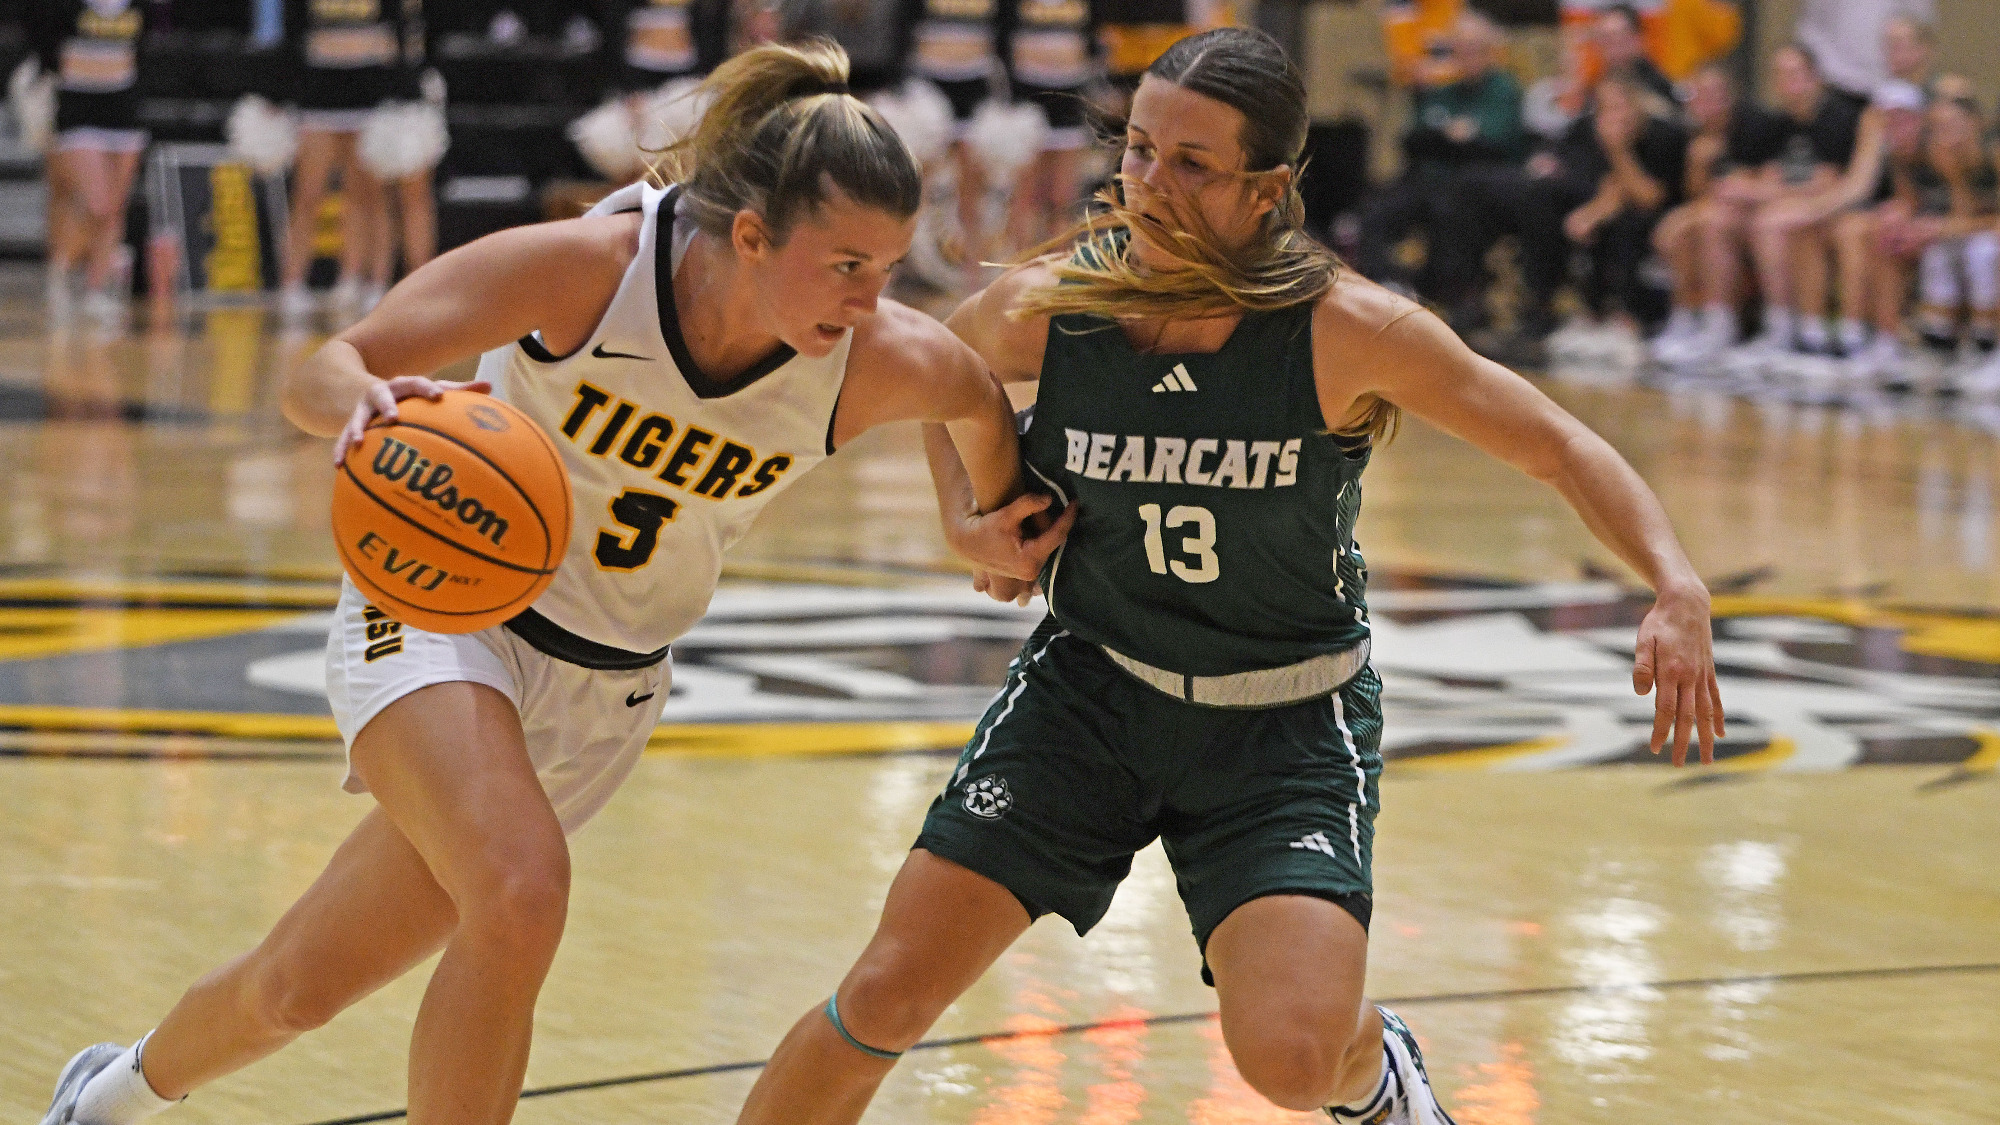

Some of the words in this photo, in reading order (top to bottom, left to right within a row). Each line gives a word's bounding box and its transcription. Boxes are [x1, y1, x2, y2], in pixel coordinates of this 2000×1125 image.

[559, 379, 794, 502] TIGERS
[1064, 427, 1302, 489] BEARCATS
[372, 436, 510, 546] Wilson
[1138, 503, 1220, 583] 13
